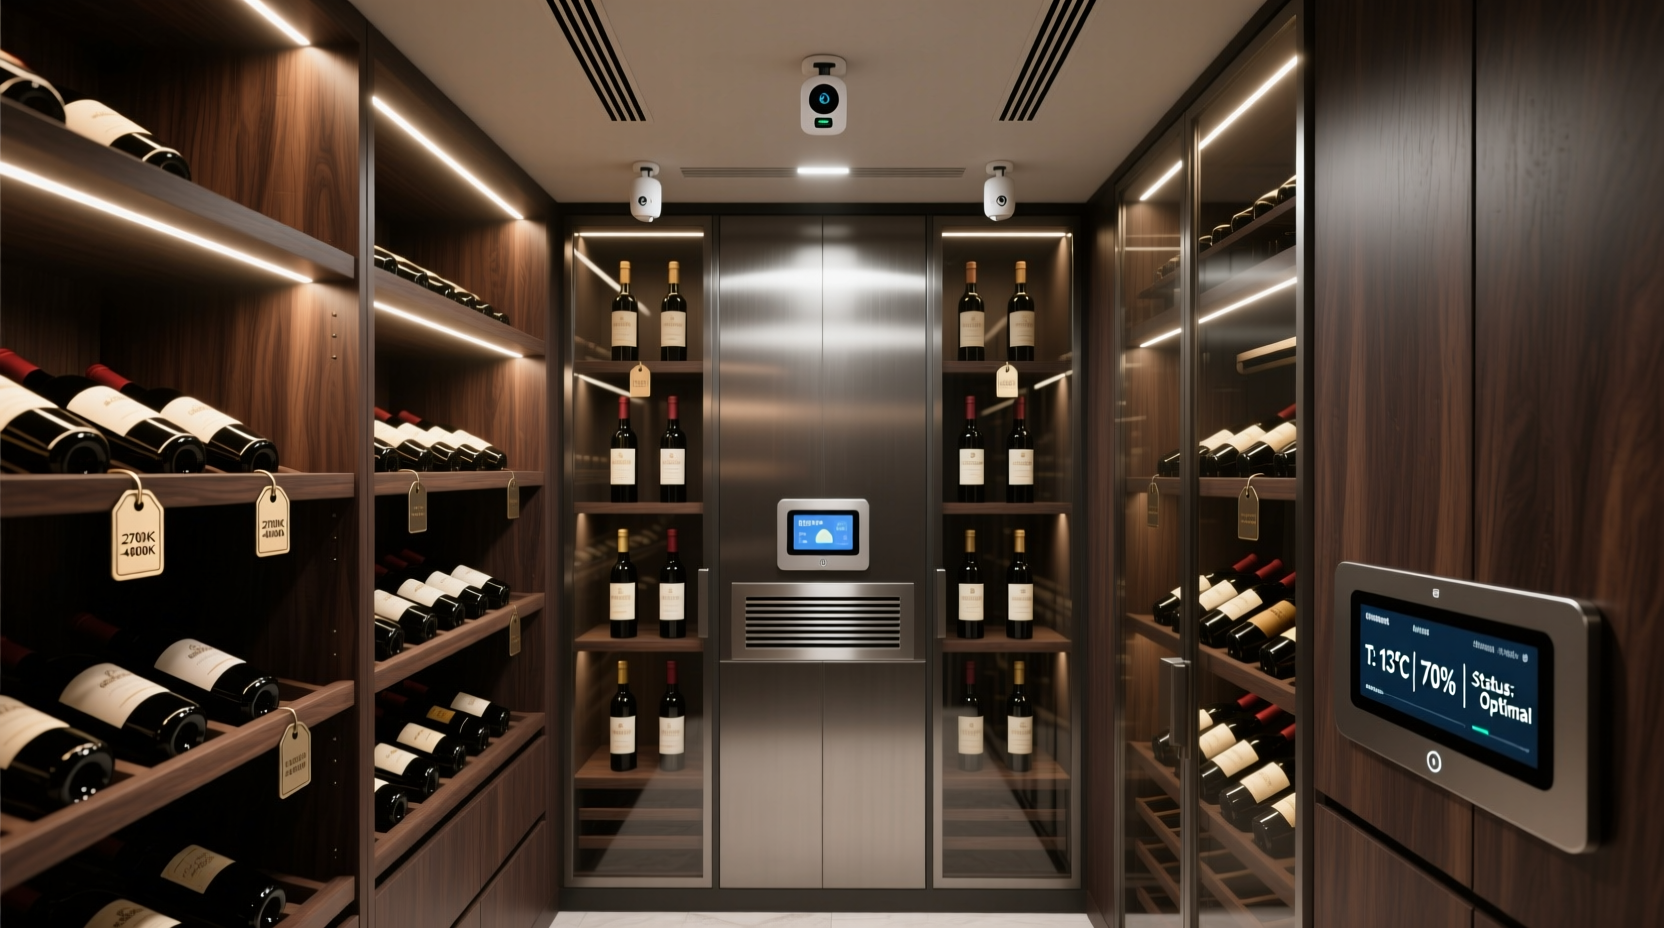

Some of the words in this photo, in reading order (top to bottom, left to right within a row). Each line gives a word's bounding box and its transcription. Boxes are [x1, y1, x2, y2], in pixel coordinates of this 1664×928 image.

[121, 531, 156, 545] 2700K
[1364, 643, 1377, 667] T:
[1379, 647, 1410, 679] 13°C
[1420, 659, 1457, 696] 70%
[1471, 670, 1515, 698] Status:
[1479, 691, 1532, 725] Optimal
